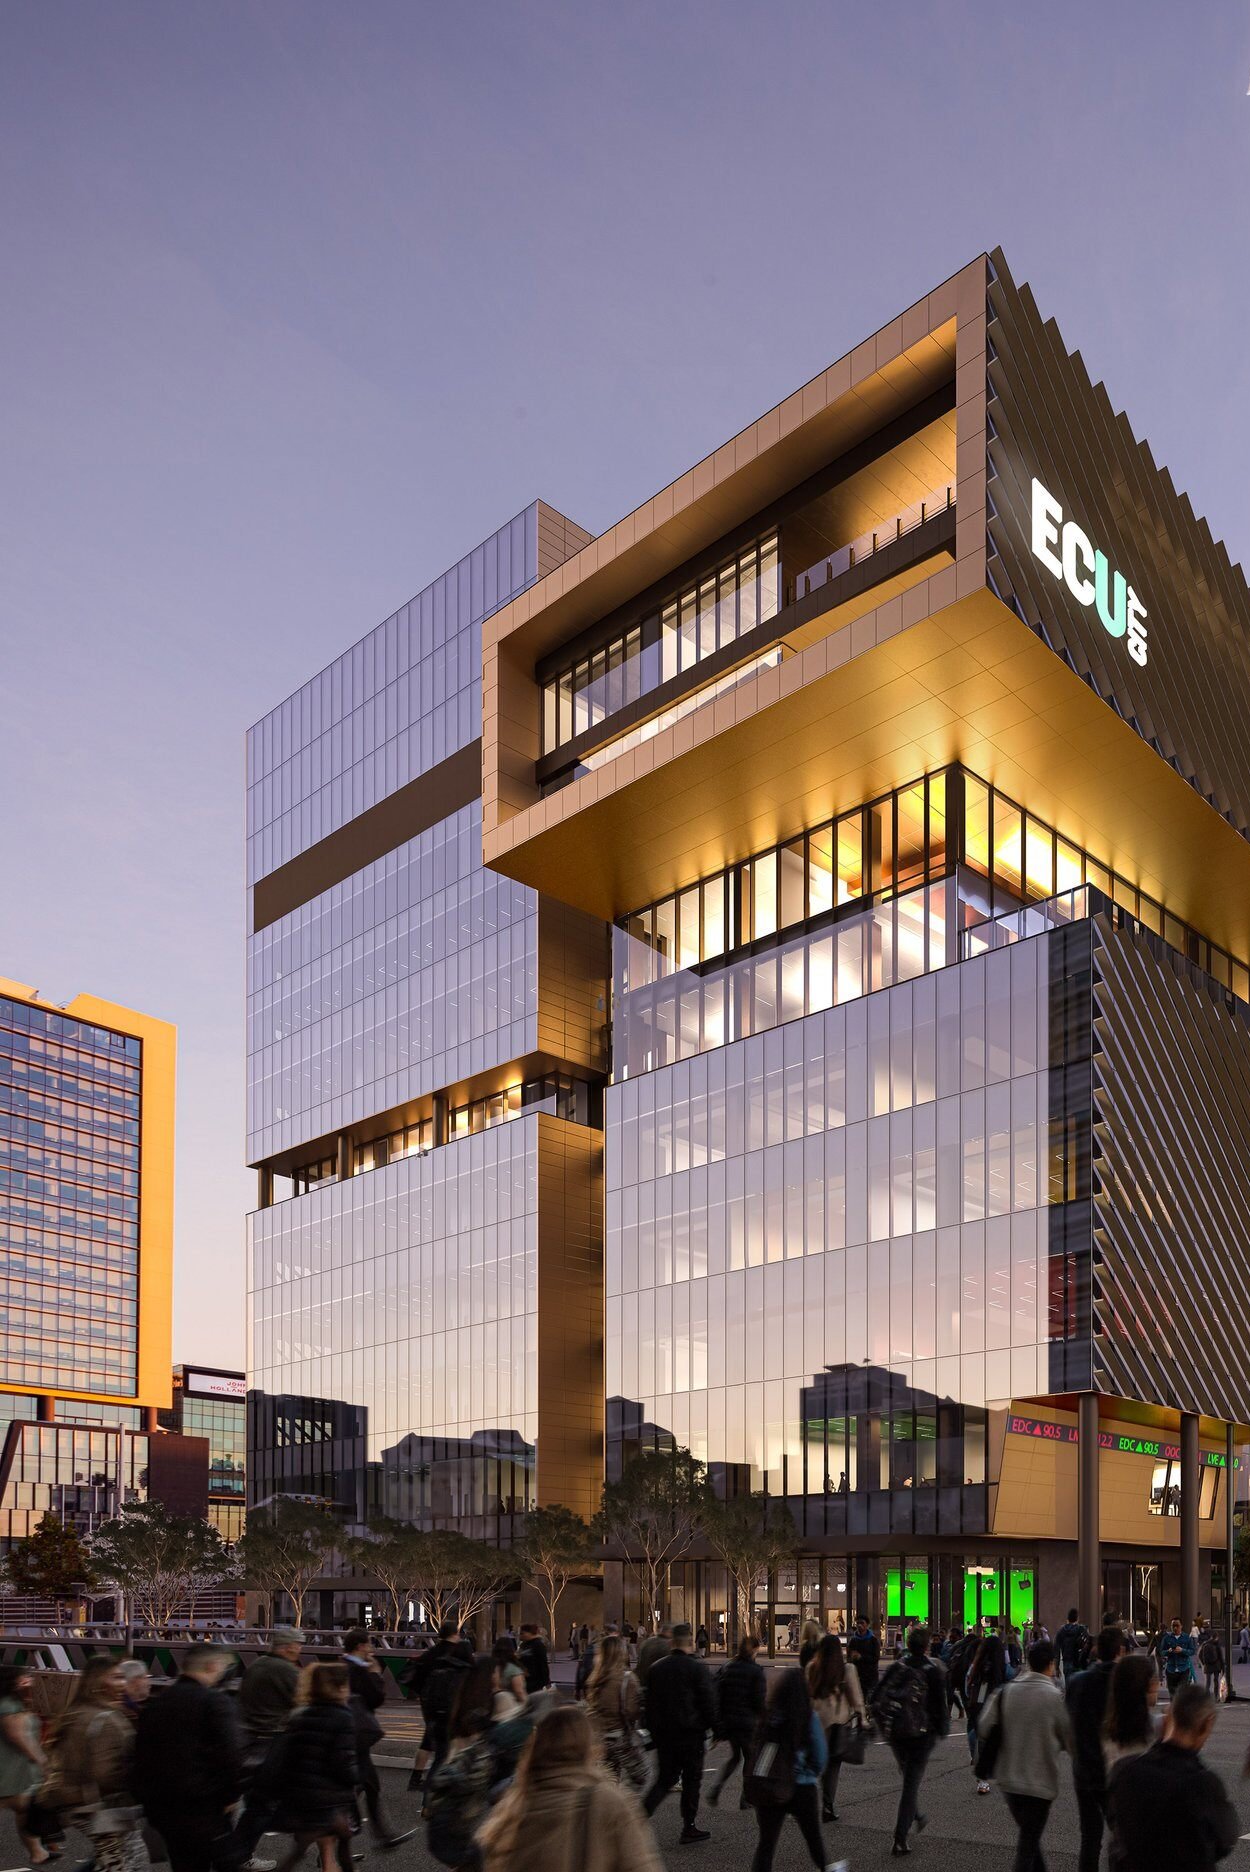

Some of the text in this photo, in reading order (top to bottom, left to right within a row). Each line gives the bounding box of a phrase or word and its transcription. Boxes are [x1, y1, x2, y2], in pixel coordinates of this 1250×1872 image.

[1031, 477, 1127, 638] ECU
[1012, 1418, 1032, 1434] EDC
[1043, 1425, 1062, 1439] 90.5
[1119, 1437, 1136, 1451] EDC
[1143, 1441, 1159, 1455] 90.5
[1207, 1453, 1219, 1465] LVE
